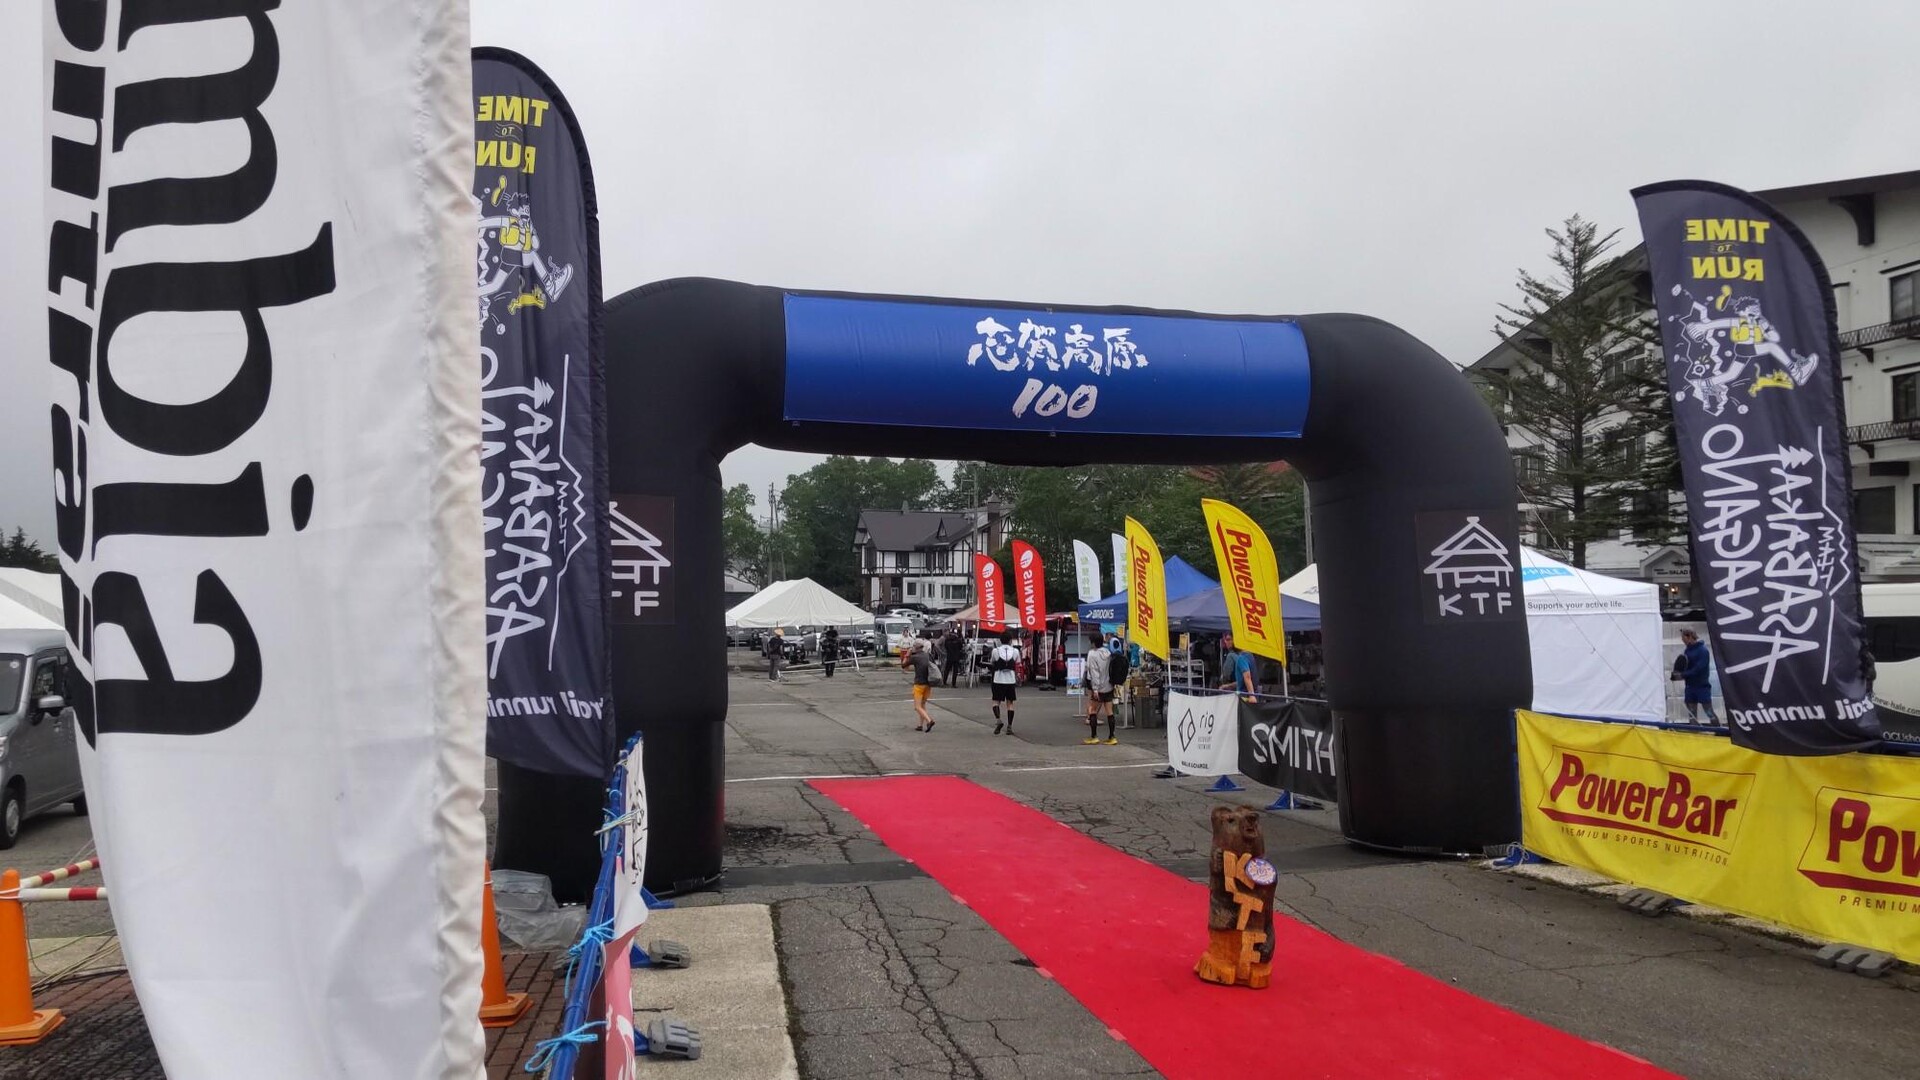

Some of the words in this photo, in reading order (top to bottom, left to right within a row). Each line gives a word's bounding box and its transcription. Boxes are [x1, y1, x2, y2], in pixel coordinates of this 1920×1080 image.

[968, 316, 1149, 376] 志賀高原
[1012, 378, 1099, 419] 100
[1136, 545, 1153, 637] PowerBar
[1226, 528, 1267, 640] PowerBar
[1438, 592, 1512, 616] KTF
[1527, 601, 1563, 611] Supports
[1565, 602, 1583, 611] your
[1585, 600, 1608, 609] active
[1251, 722, 1336, 777] SMITH
[1550, 752, 1738, 838] PowerBar
[1561, 826, 1609, 841] PREMIUM
[1615, 834, 1659, 849] SPORTS
[1665, 843, 1729, 866] NUTRITION
